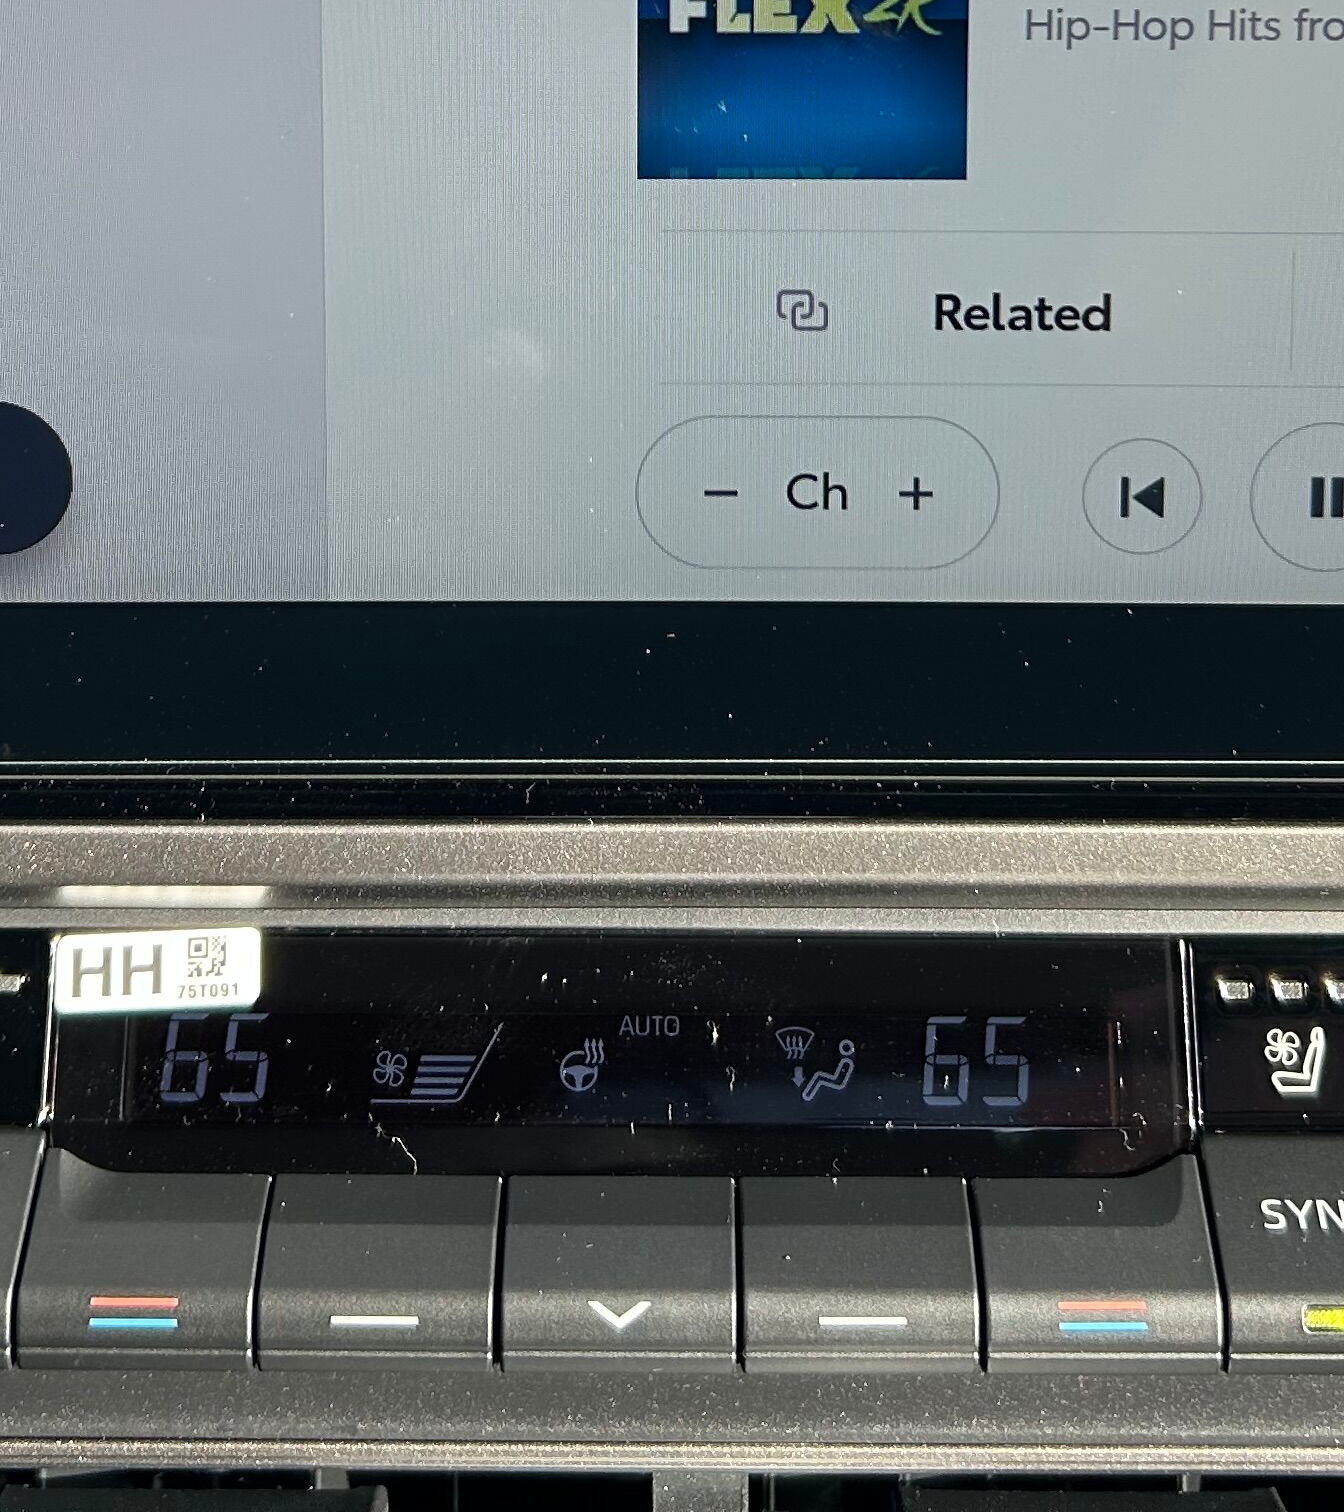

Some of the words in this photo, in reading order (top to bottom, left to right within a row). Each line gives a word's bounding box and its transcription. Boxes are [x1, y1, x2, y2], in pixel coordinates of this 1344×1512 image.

[1026, 8, 1194, 50] Hip-Hop
[1209, 8, 1281, 41] Hits
[935, 293, 1111, 331] Related
[787, 472, 847, 510] Ch
[72, 944, 162, 998] HH
[179, 983, 237, 998] 75T091
[619, 1016, 679, 1036] AUTO
[160, 1013, 269, 1102] 65
[923, 1017, 1028, 1107] 65
